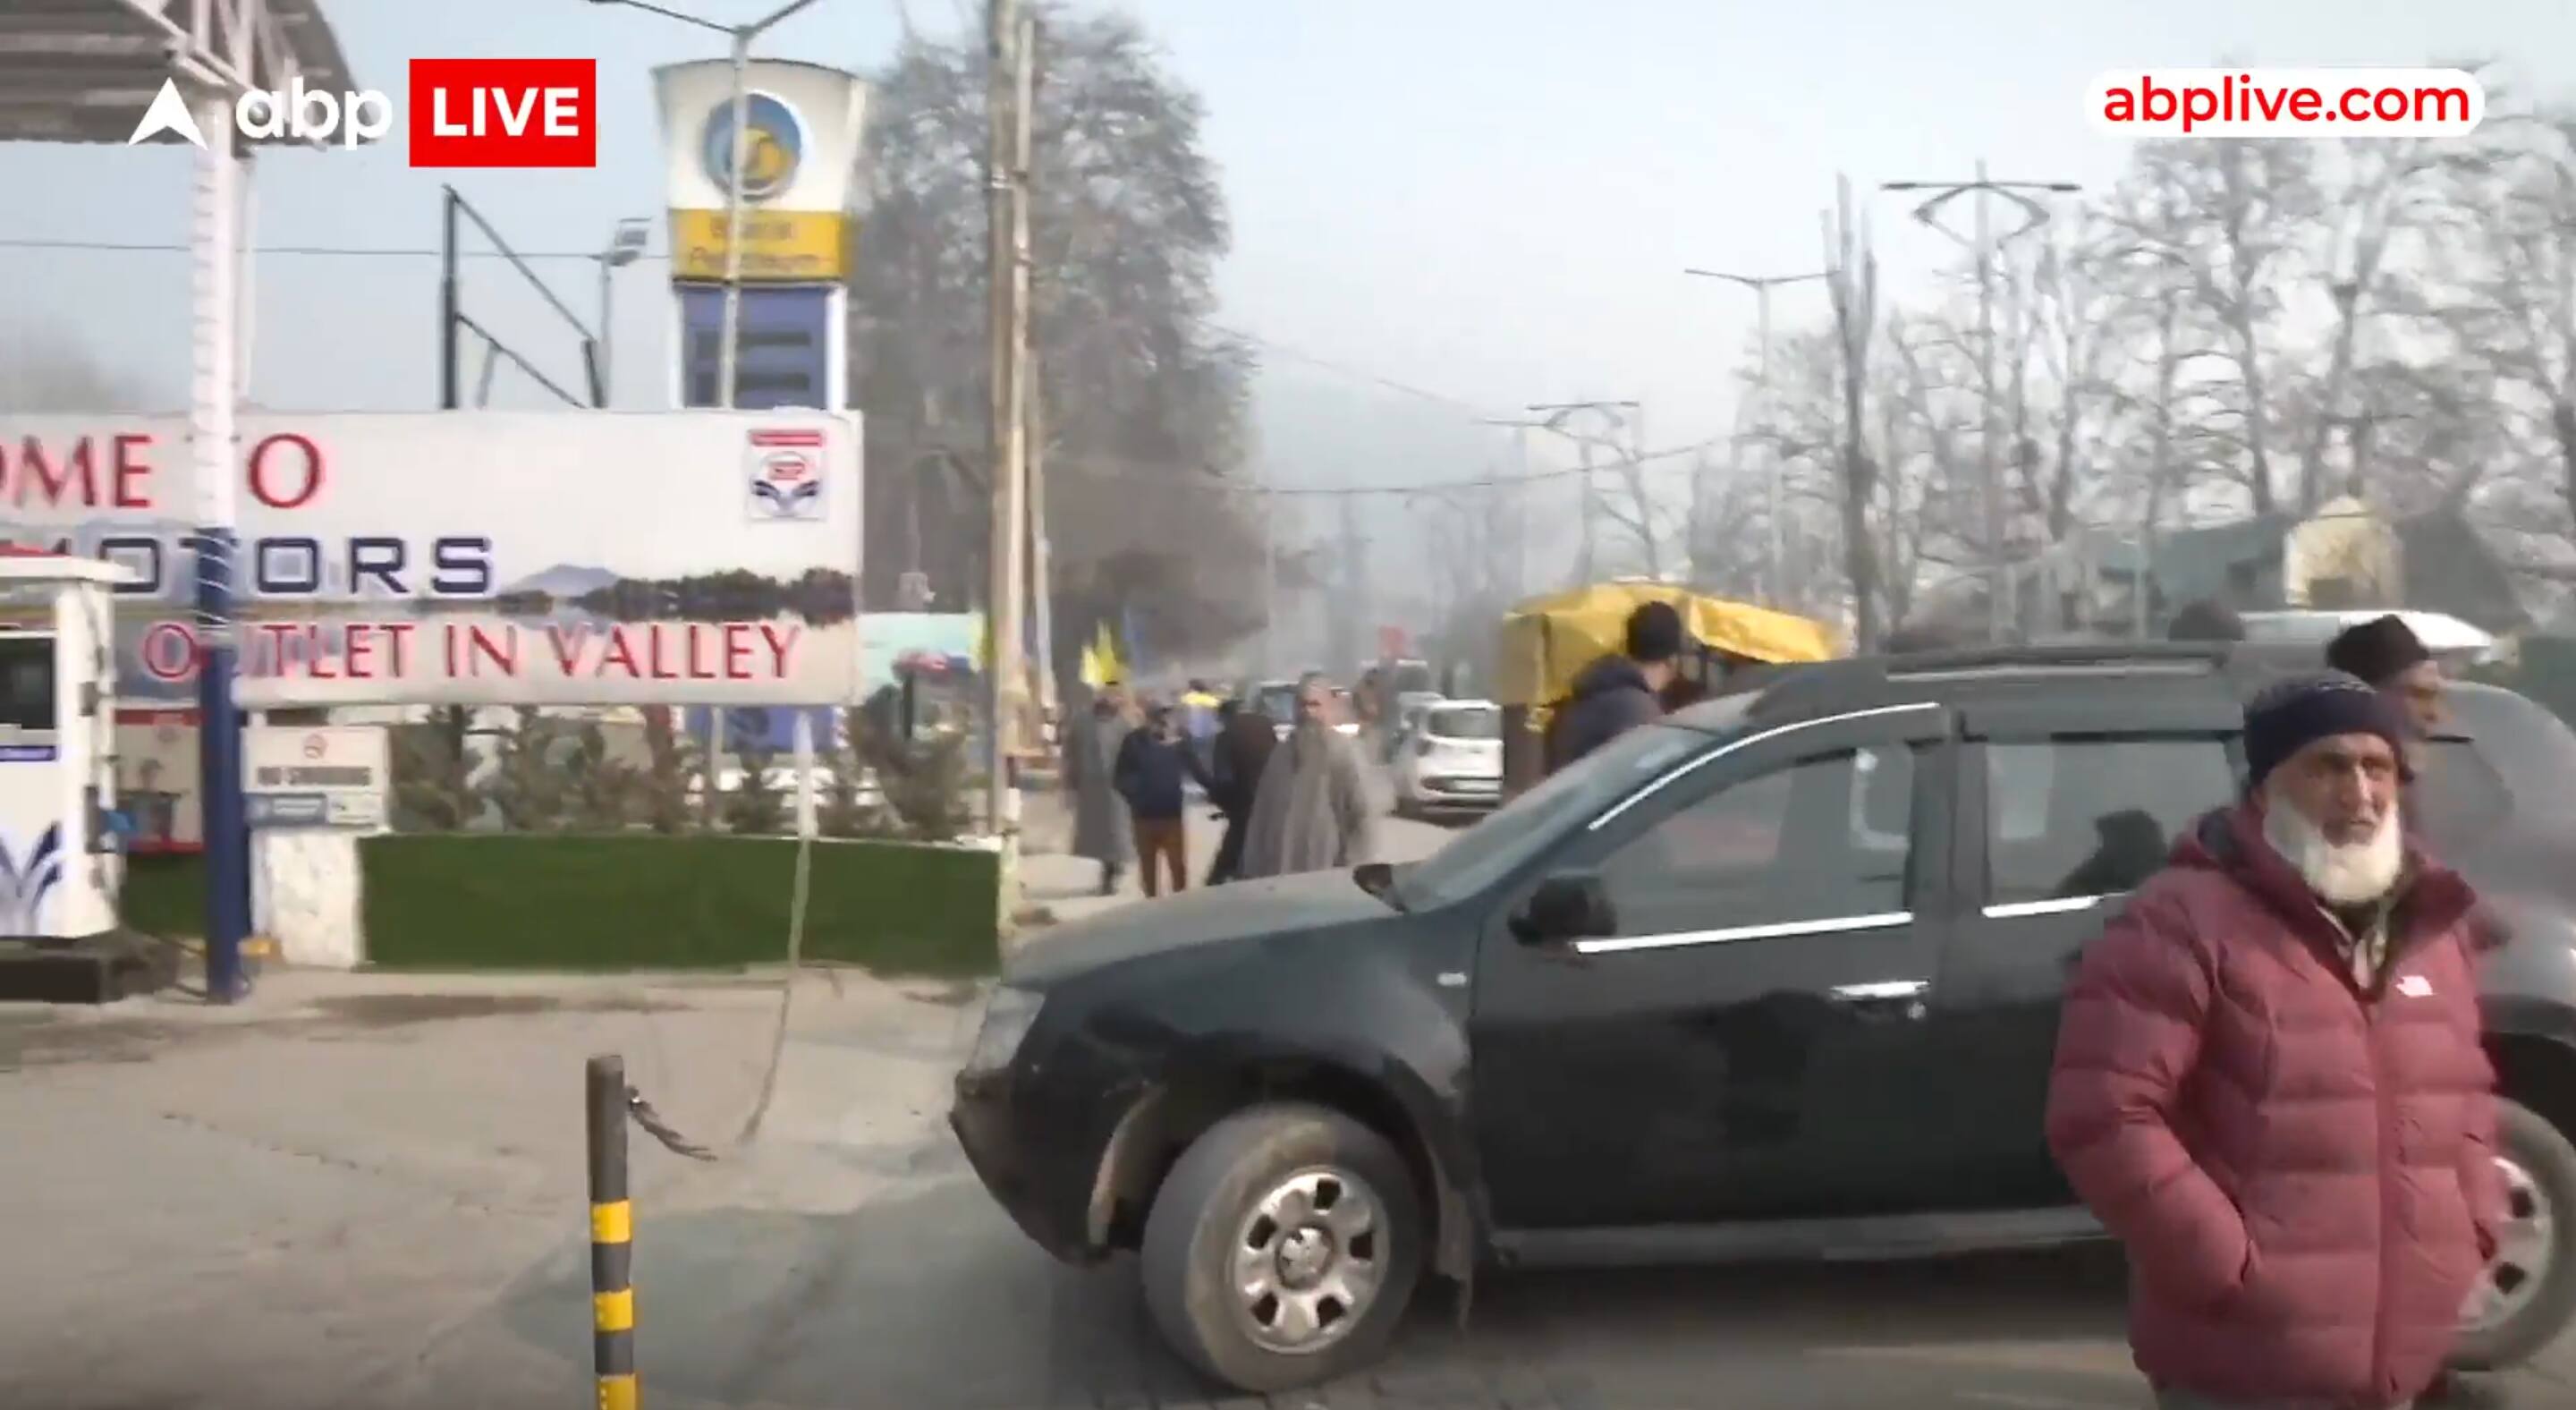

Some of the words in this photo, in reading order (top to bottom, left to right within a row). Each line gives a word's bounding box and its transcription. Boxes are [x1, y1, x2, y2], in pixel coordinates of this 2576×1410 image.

[0, 434, 152, 507] ME
[52, 538, 492, 593] OORS
[145, 624, 414, 677] OTLET
[448, 624, 519, 677] IN
[545, 624, 801, 677] VALLEY
